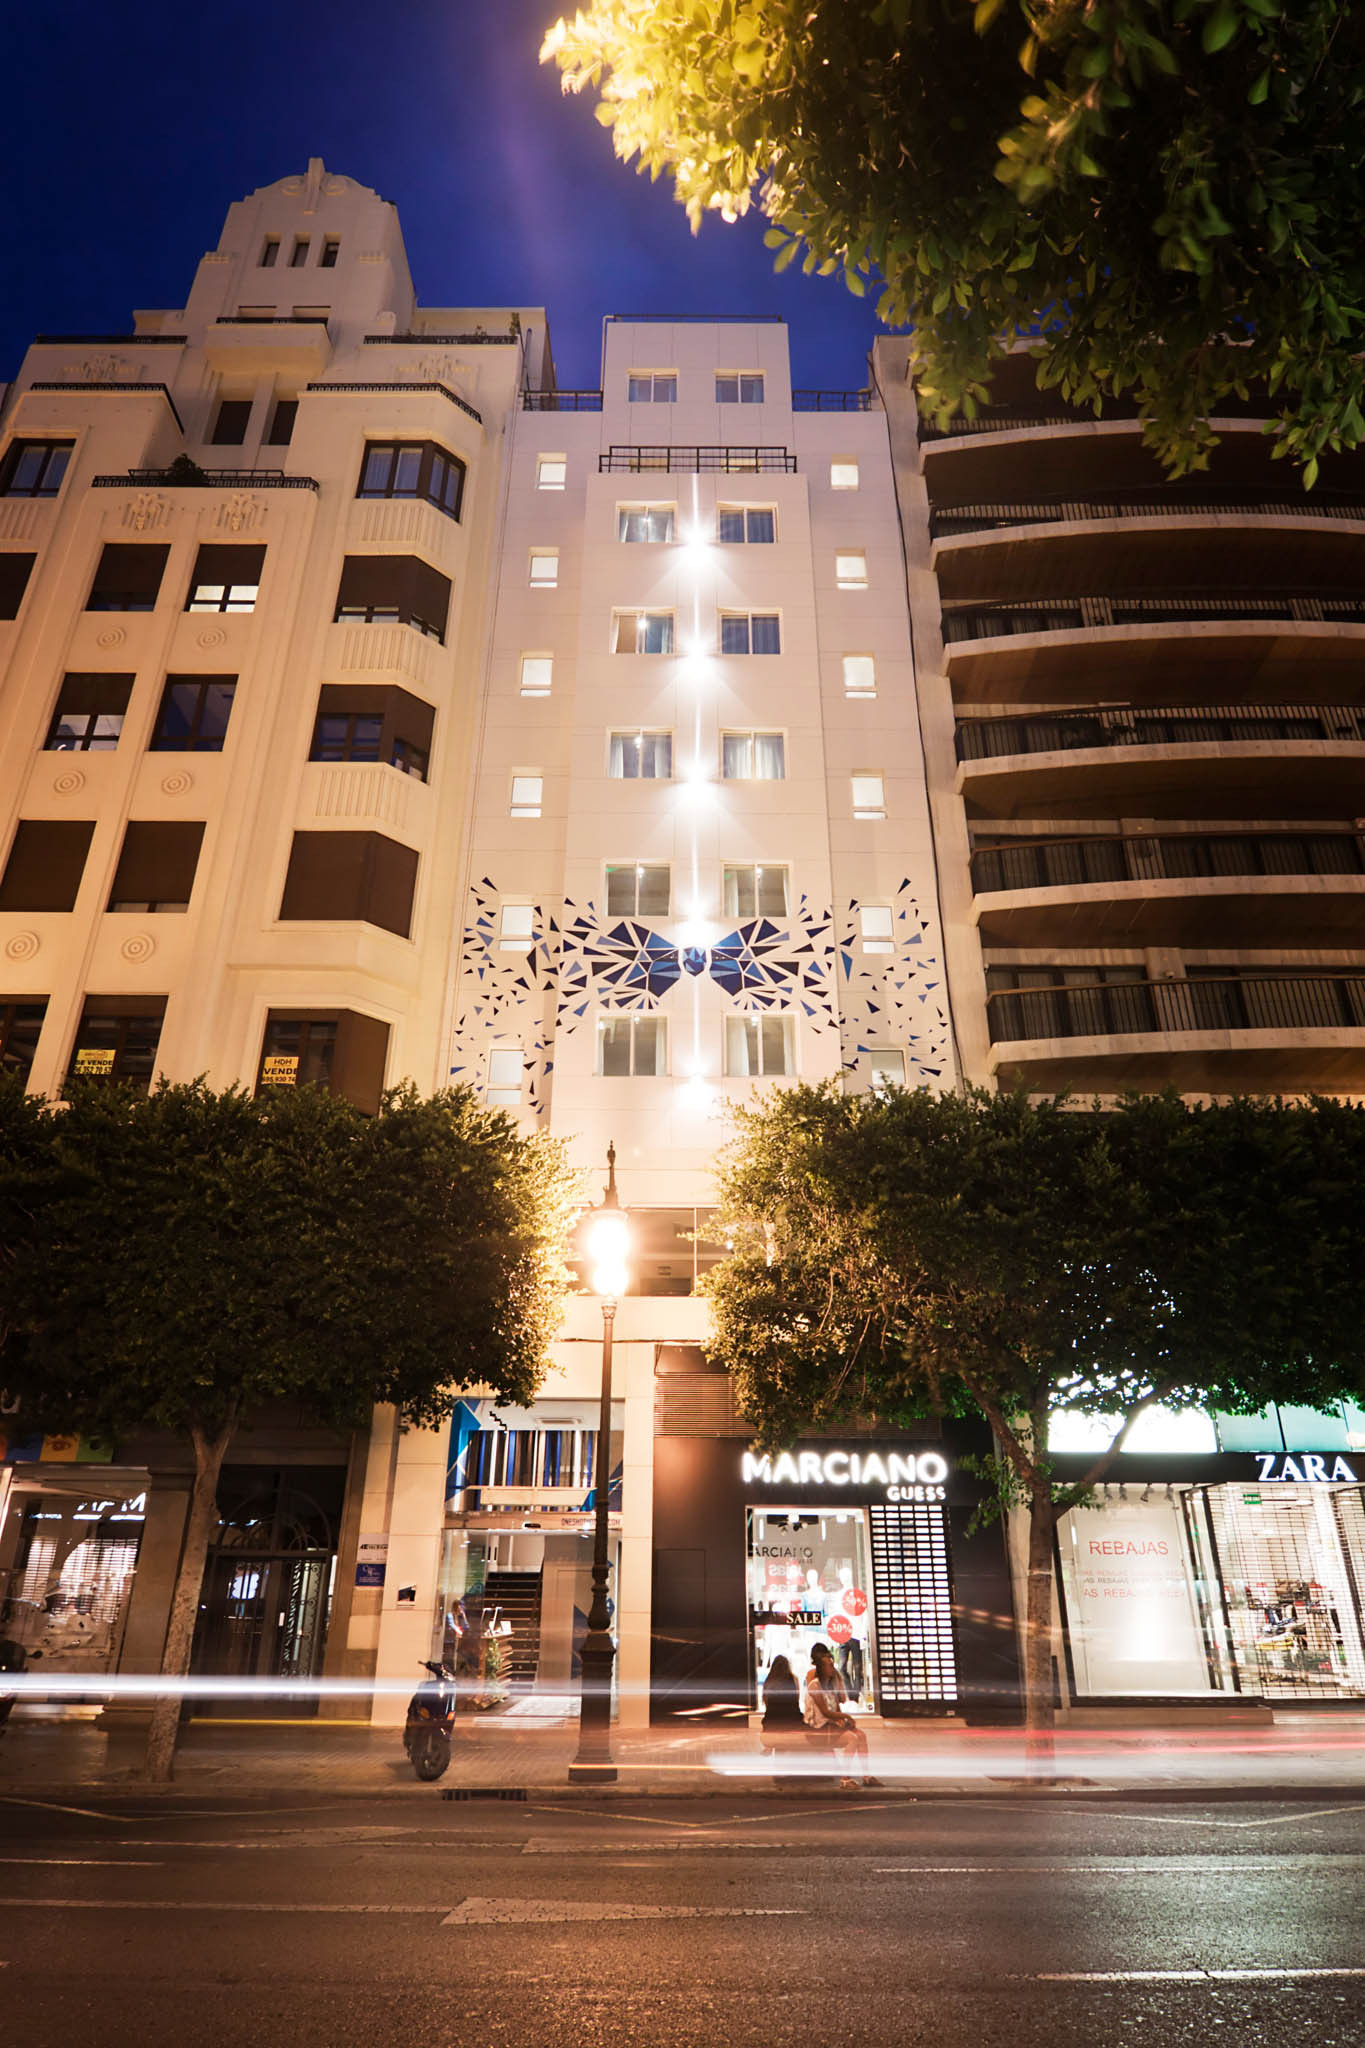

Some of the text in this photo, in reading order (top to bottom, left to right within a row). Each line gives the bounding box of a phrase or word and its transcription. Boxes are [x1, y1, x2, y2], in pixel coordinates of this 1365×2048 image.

[741, 1452, 949, 1484] MARCIANO
[1255, 1455, 1358, 1482] ZARA
[887, 1486, 946, 1502] GUESS
[1088, 1541, 1168, 1555] REBAJAS
[786, 1613, 822, 1624] SALE
